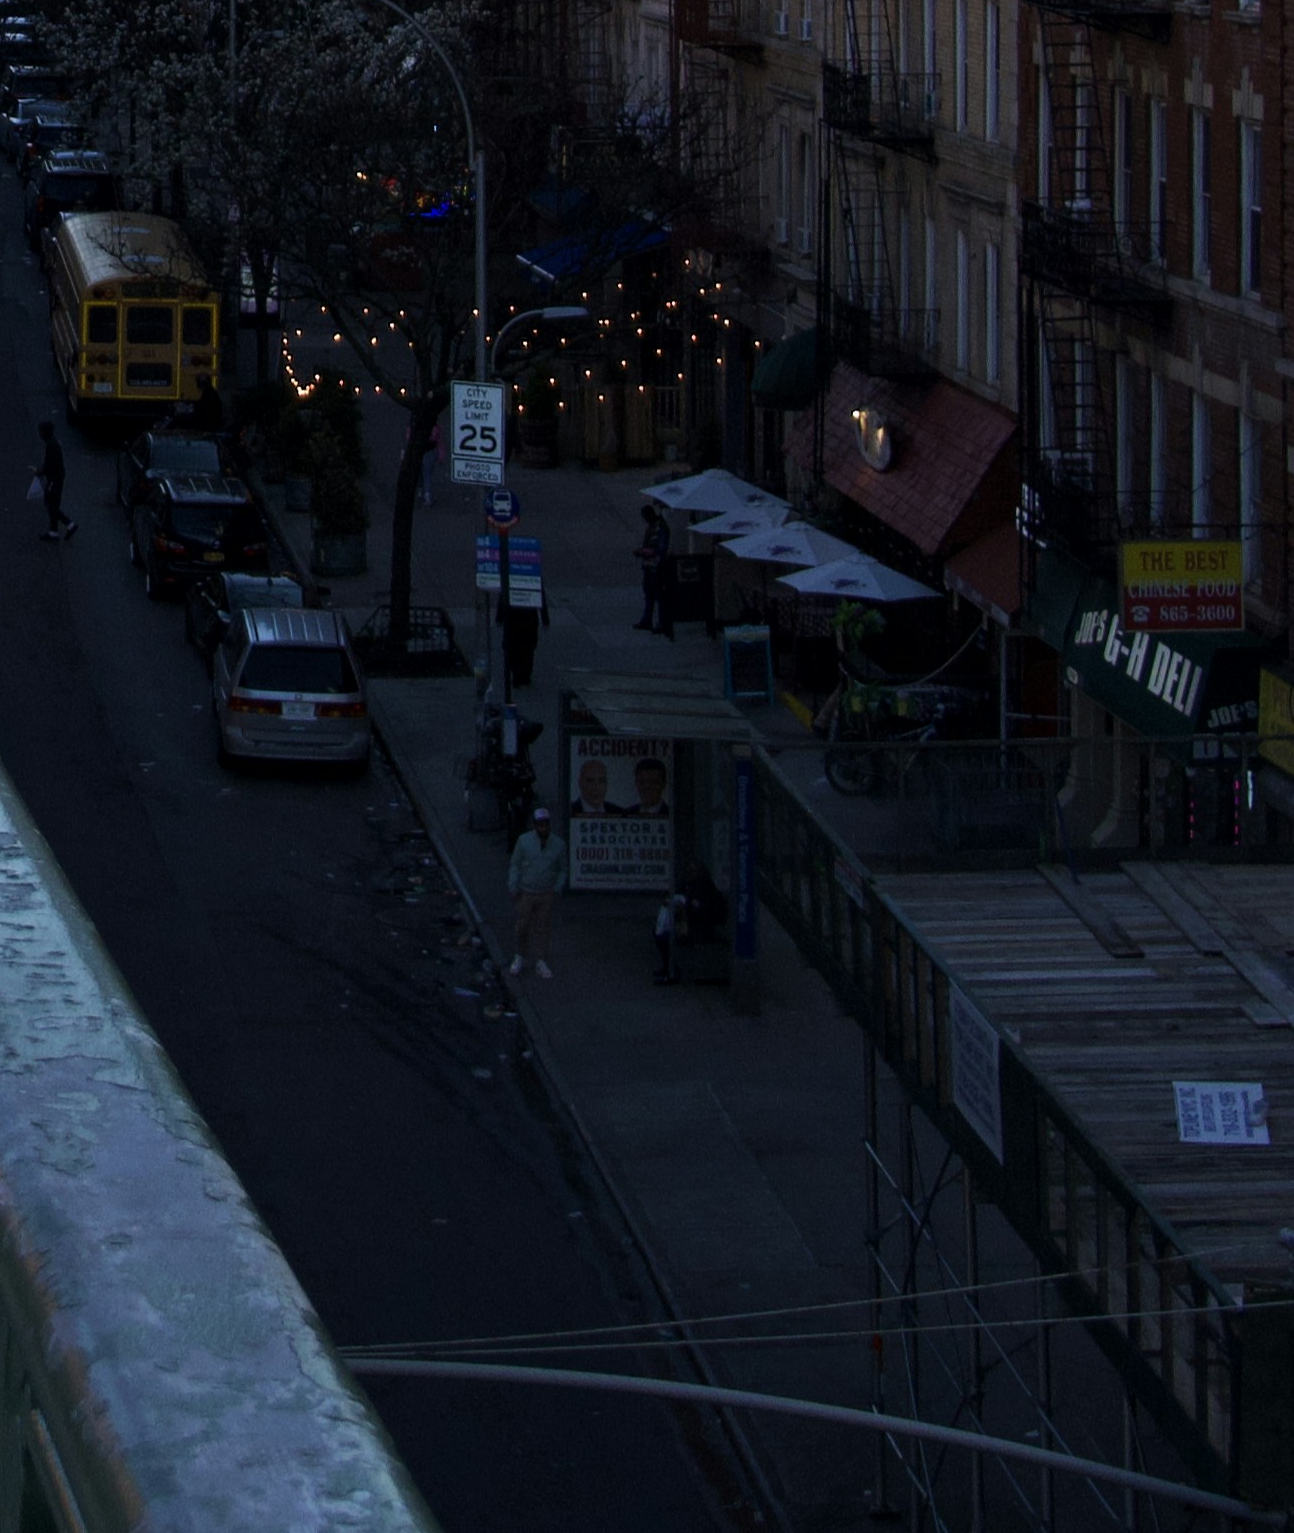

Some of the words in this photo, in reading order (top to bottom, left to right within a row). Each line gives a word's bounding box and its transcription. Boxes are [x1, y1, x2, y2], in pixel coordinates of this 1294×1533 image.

[467, 388, 488, 398] CITY
[462, 399, 493, 410] SPEED
[465, 411, 489, 421] LIMIT
[459, 424, 497, 453] 25
[457, 469, 499, 482] ENFORCED
[465, 462, 491, 472] PHOTO
[1140, 551, 1174, 571] THE
[1185, 549, 1228, 571] BEST
[1128, 579, 1189, 598] CHINESE
[1196, 578, 1236, 598] FOOD
[1159, 605, 1236, 622] 865-3600
[1104, 613, 1150, 682] G-H
[1147, 641, 1203, 718] DELI
[1207, 699, 1258, 729] JOE'S
[578, 738, 670, 757] ACCIDENT?
[580, 822, 650, 833] SPEKTOR
[580, 835, 666, 845] ASSOCIATES
[737, 893, 749, 923] Place
